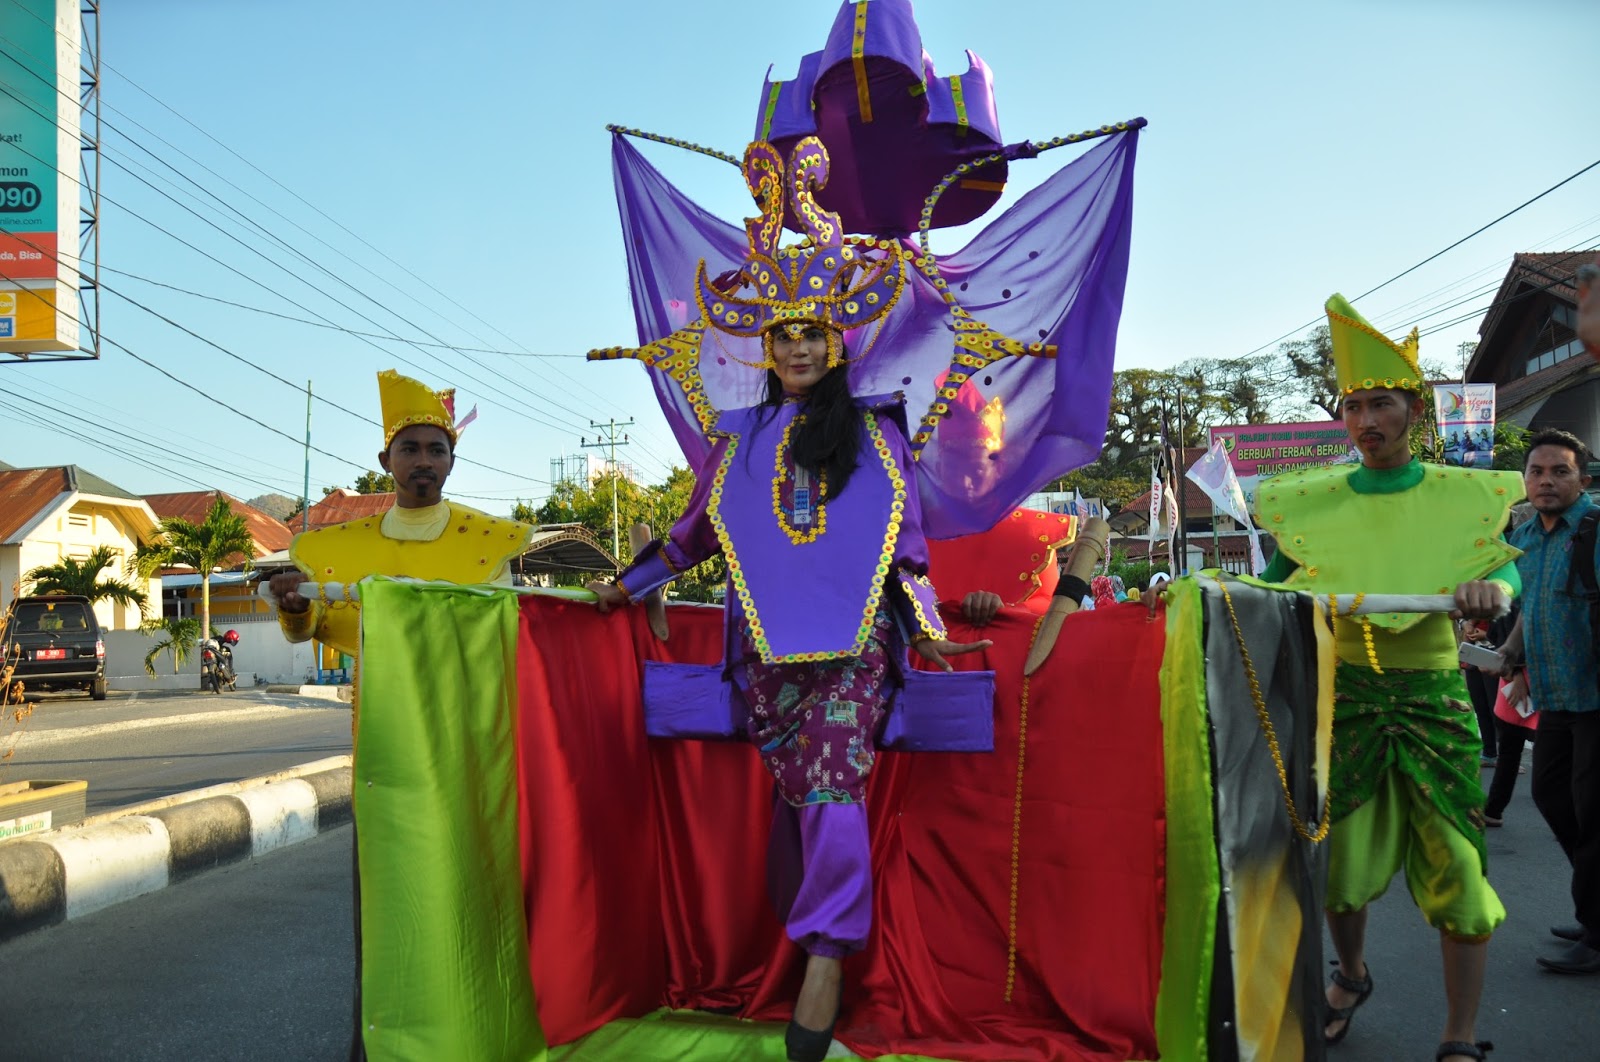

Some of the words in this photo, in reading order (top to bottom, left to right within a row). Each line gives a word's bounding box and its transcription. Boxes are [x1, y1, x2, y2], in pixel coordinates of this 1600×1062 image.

[19, 250, 42, 260] Bisa
[1237, 447, 1277, 460] BERBUAT
[1277, 445, 1315, 459] TERBAIK,
[1256, 464, 1284, 476] TULUS
